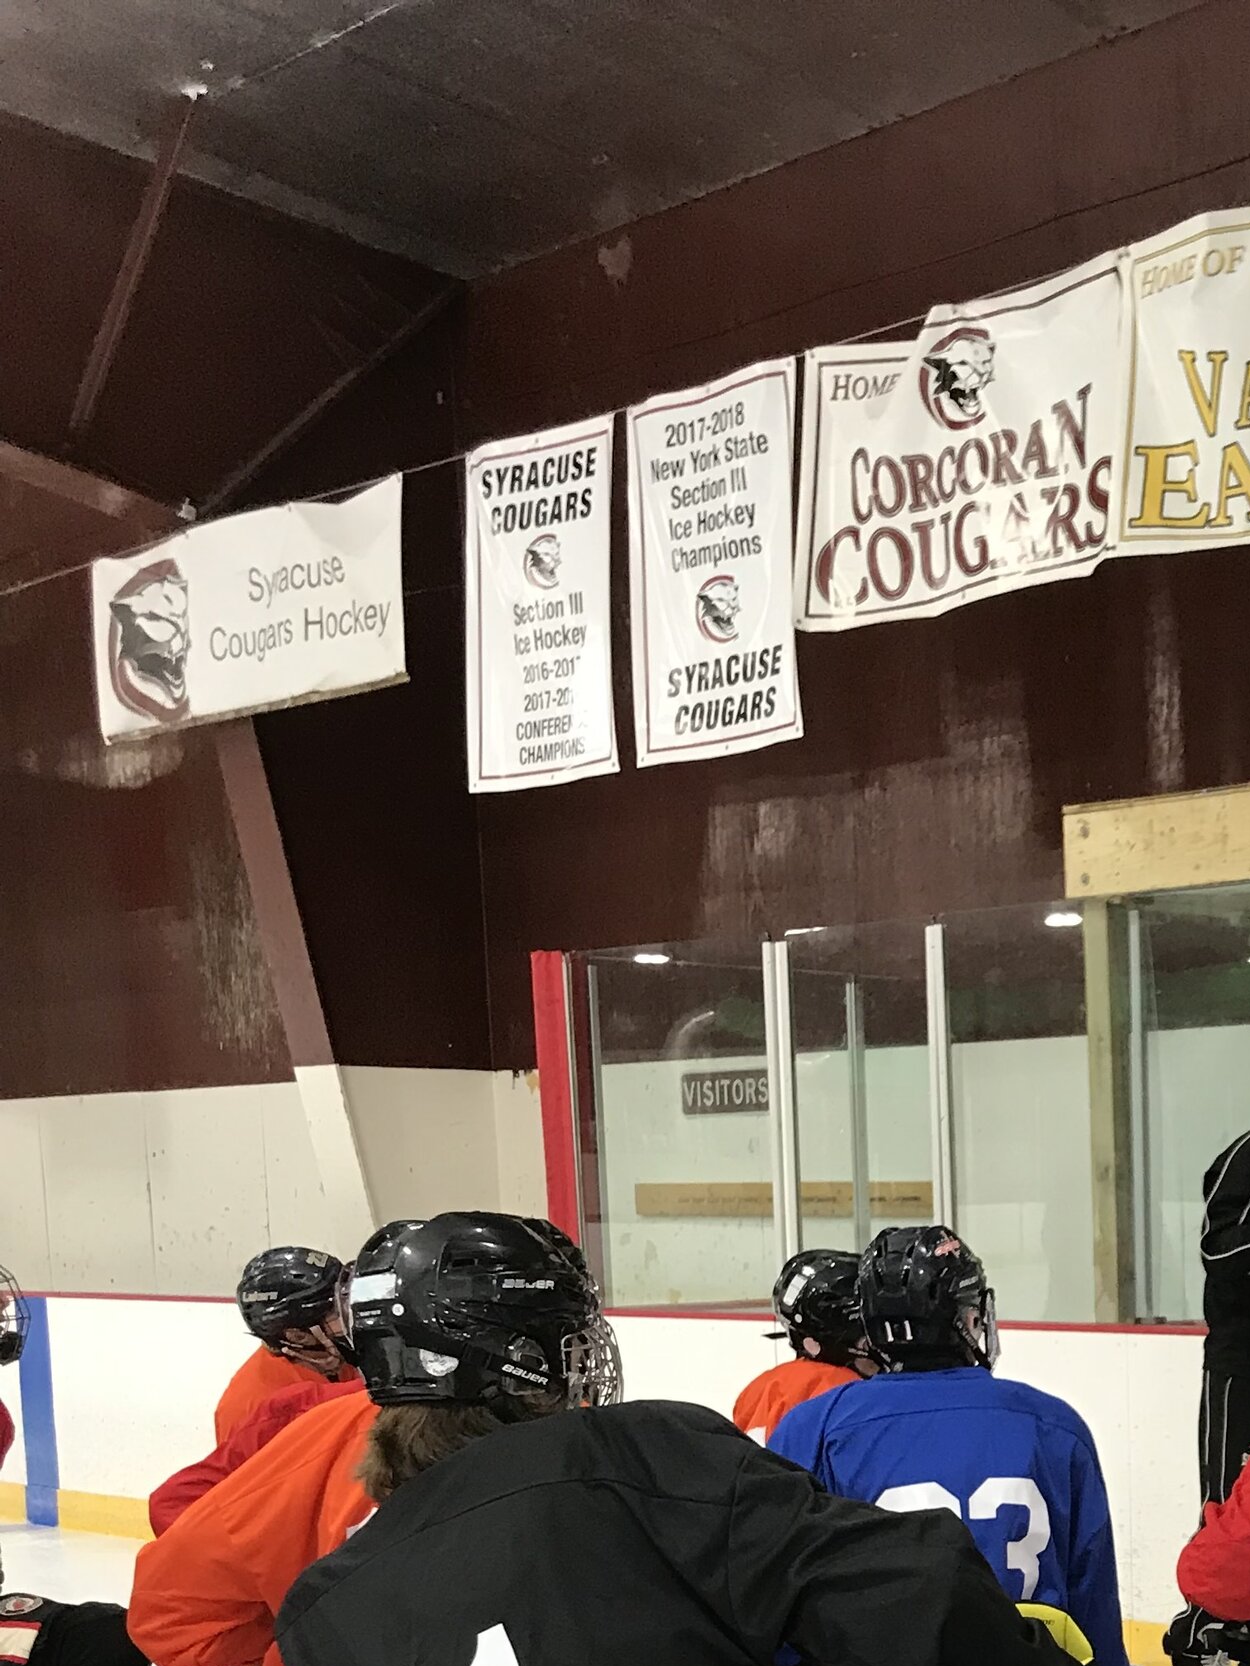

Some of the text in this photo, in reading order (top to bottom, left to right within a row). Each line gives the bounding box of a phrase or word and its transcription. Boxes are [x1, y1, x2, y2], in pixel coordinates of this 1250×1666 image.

[1140, 245, 1246, 299] HOME OF
[830, 372, 902, 401] HOME
[665, 402, 744, 448] 2017-2018
[482, 447, 597, 499] SYRACUSE
[650, 431, 769, 484] New York State
[851, 382, 1093, 524] CORCORAN
[671, 466, 747, 509] Section III
[491, 488, 592, 536] COUGARS
[669, 503, 756, 541] Ice Hockey
[671, 535, 762, 573] Champions
[248, 556, 345, 608] Syracuse
[513, 591, 583, 626] Section III
[210, 599, 391, 662] Cougars Hockey
[514, 624, 587, 656] Ice Hockey
[523, 655, 581, 684] 2016-201
[667, 644, 783, 698] SYRACUSE
[524, 687, 575, 712] 2017-20
[674, 686, 777, 735] COUGARS
[516, 714, 575, 741] CONFERE
[519, 736, 585, 765] CHAMPIONS
[683, 1077, 768, 1107] VISITORS
[884, 1319, 914, 1342] 11
[502, 1363, 549, 1386] BAUER
[874, 1477, 1052, 1600] 3
